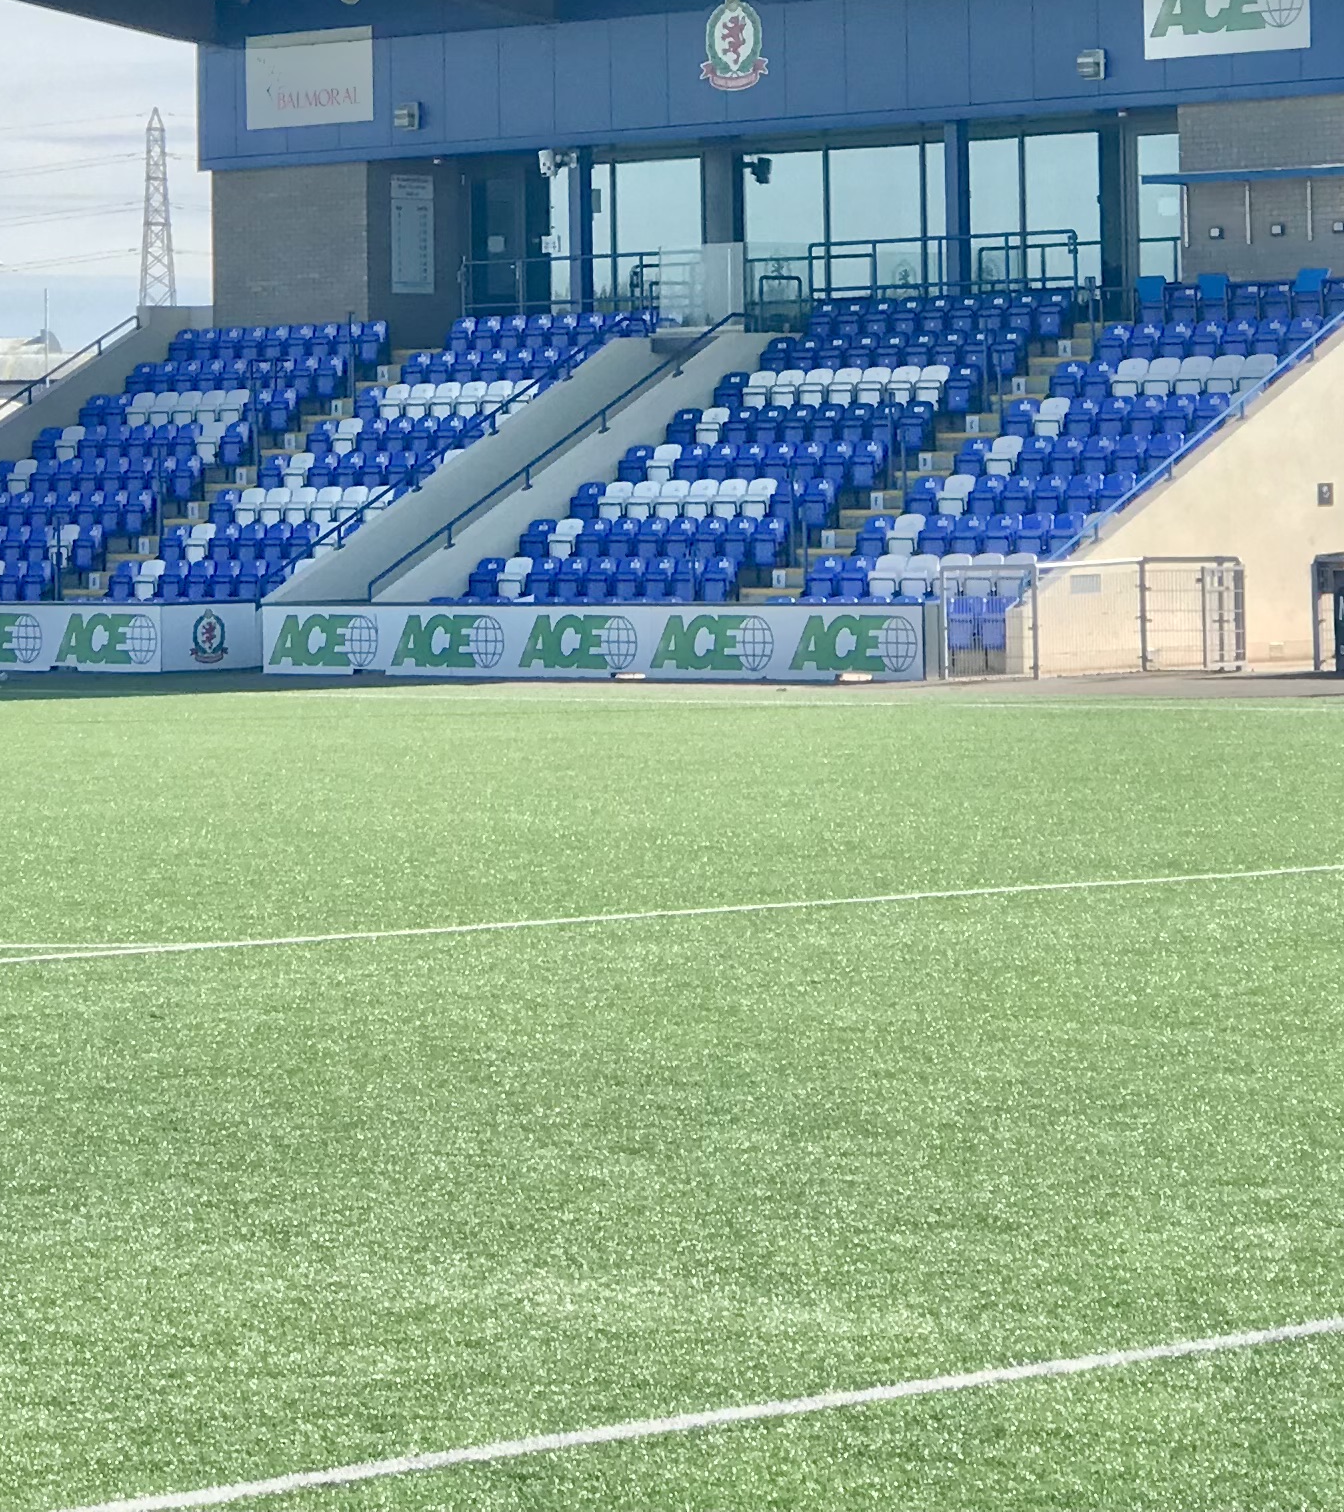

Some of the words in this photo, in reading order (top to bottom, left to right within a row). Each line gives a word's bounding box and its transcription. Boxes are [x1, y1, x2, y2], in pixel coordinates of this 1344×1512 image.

[55, 613, 136, 665] ACE
[268, 613, 354, 667] ACE
[390, 614, 480, 668] ACE
[518, 614, 613, 669] ACE
[650, 614, 747, 670] ACE
[788, 614, 890, 672] ACE
